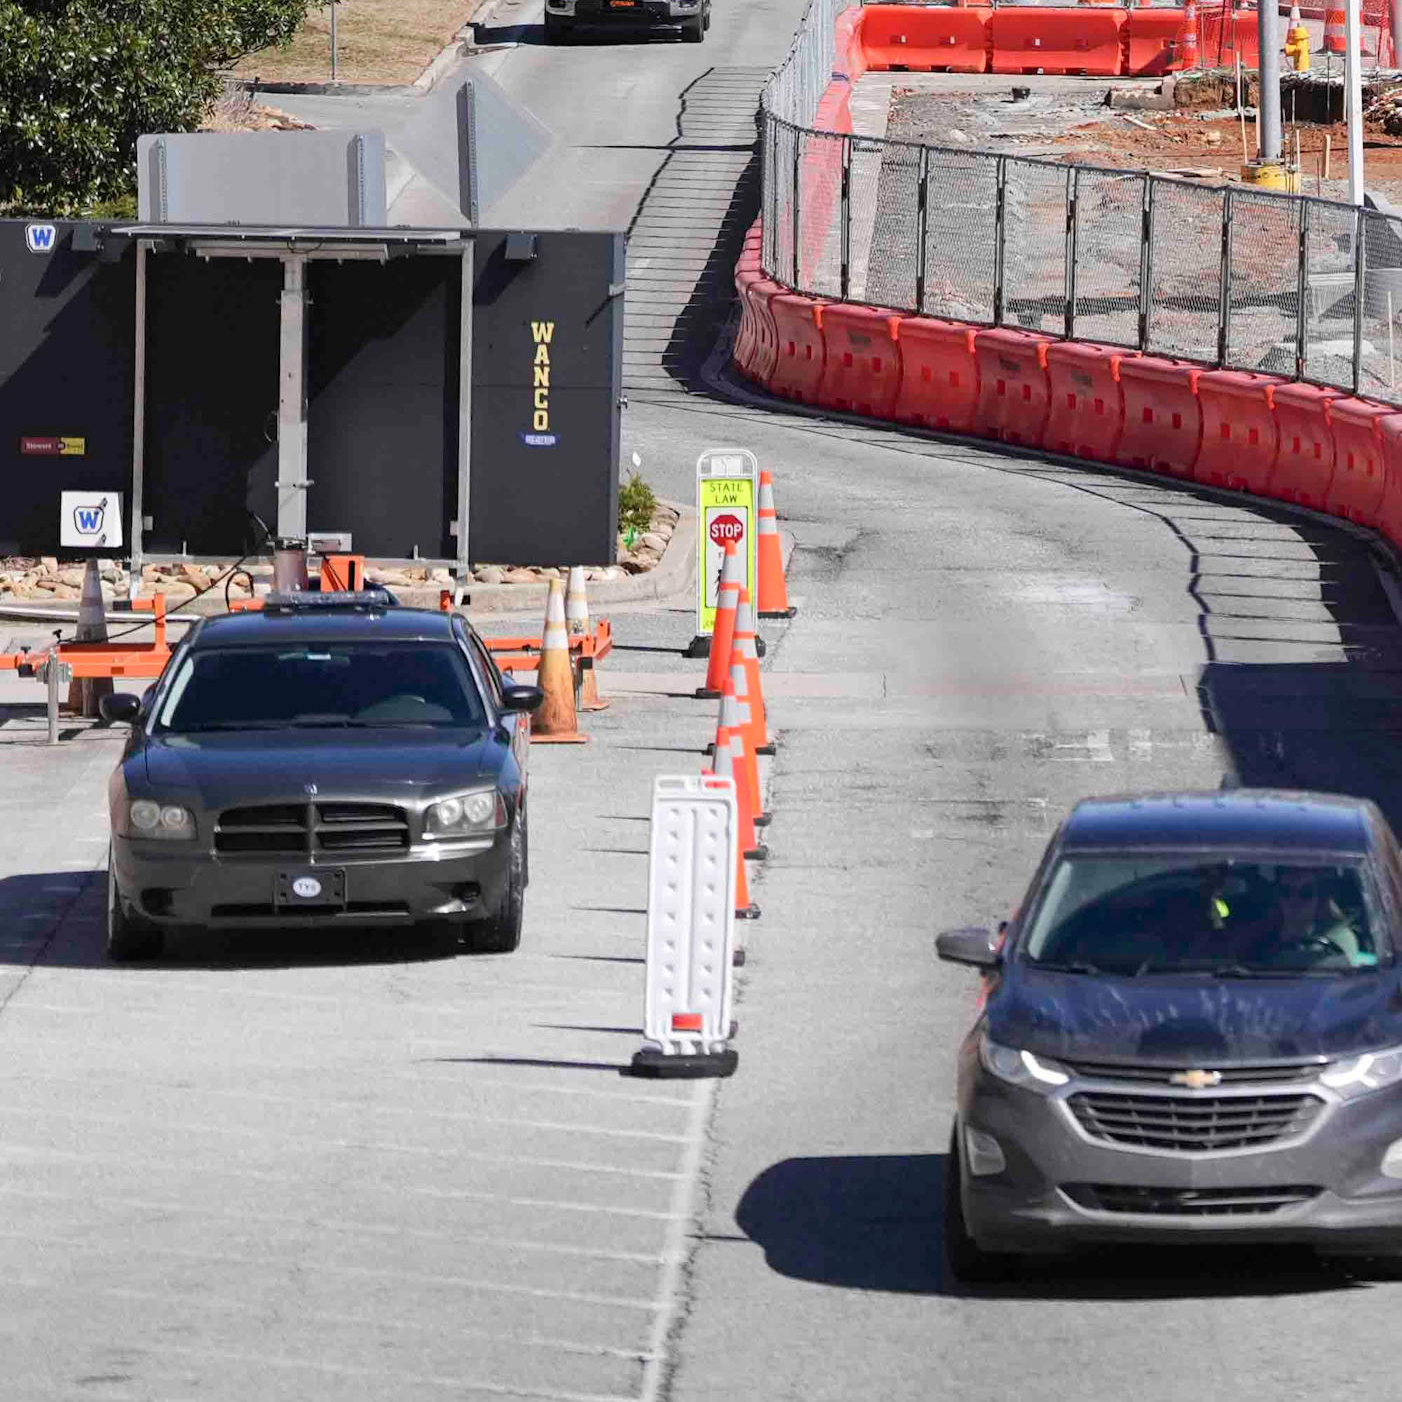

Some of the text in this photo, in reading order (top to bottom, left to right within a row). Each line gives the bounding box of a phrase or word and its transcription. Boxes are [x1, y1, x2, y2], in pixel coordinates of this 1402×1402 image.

[32, 228, 52, 247] W
[530, 321, 555, 431] WANCO
[709, 482, 744, 493] STATE
[715, 494, 738, 504] LAW
[78, 510, 99, 529] W
[711, 524, 742, 538] STOP
